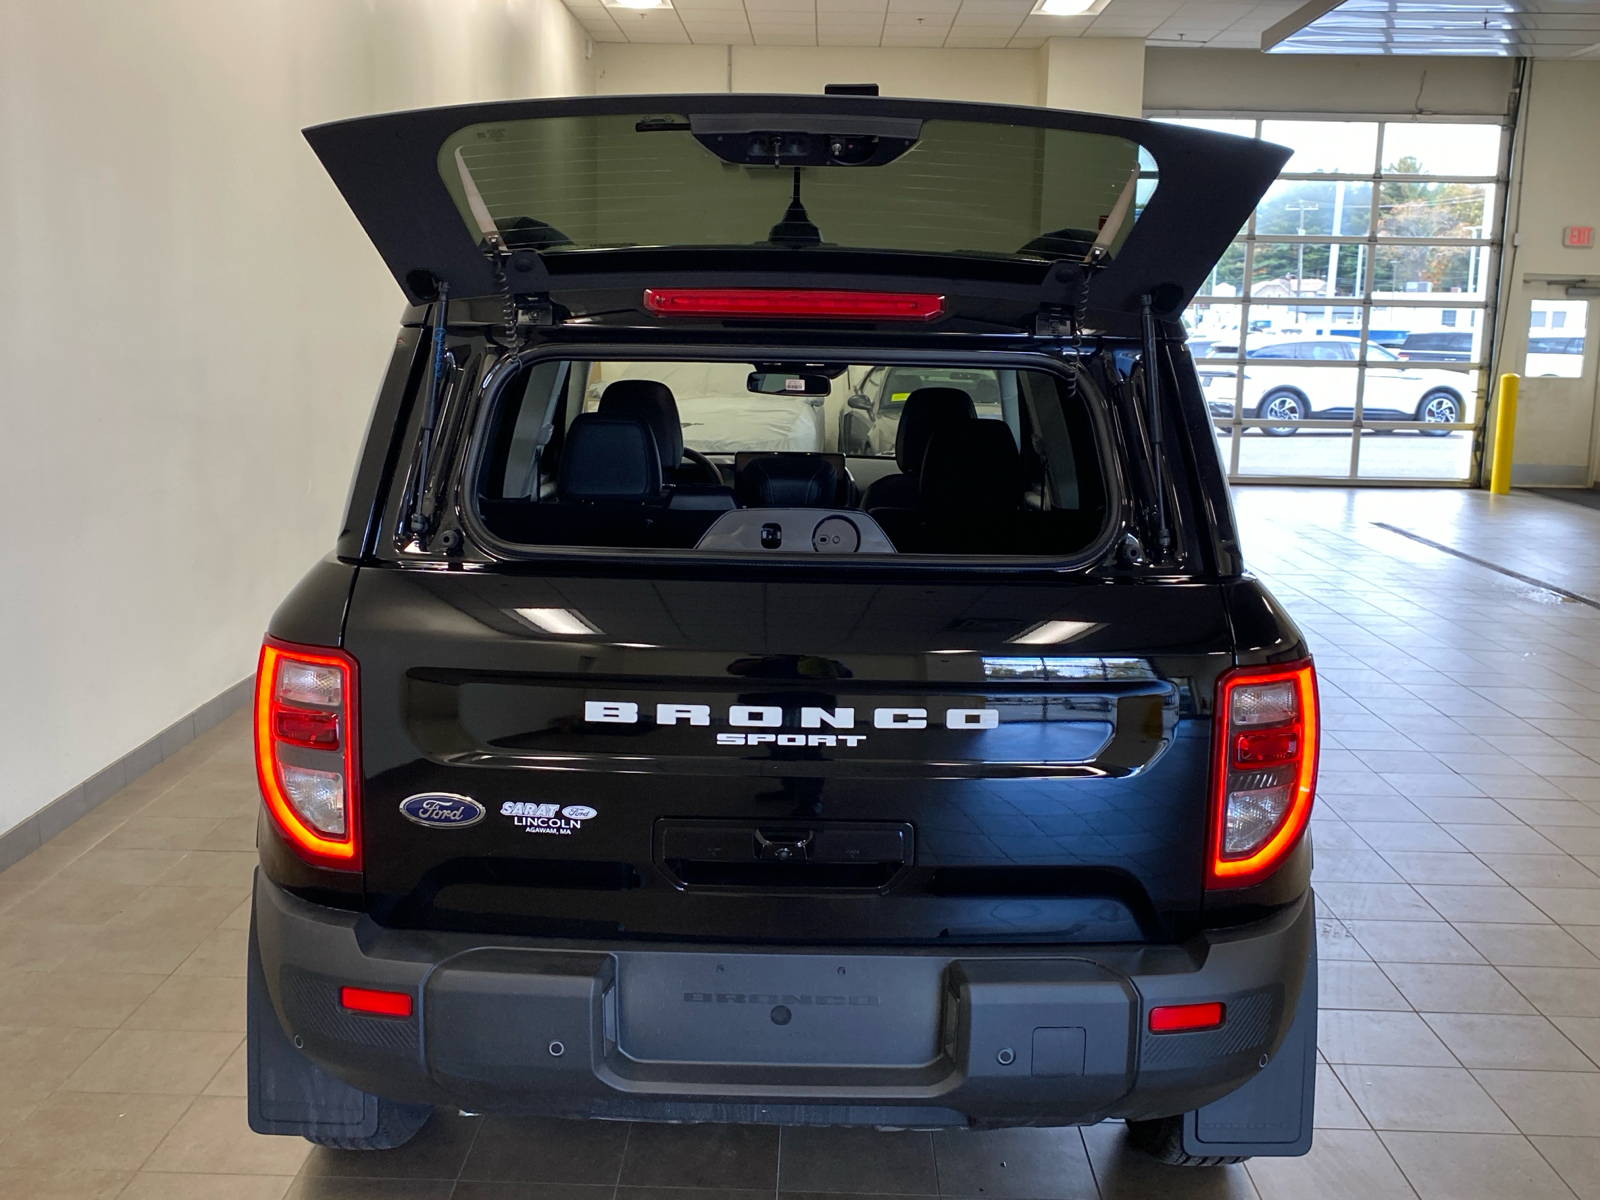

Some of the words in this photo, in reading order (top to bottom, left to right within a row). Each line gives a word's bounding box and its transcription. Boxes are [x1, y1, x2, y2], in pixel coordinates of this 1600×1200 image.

[1569, 226, 1592, 245] EXIT
[584, 701, 999, 729] BRONCO
[716, 732, 867, 747] SPORT
[418, 799, 464, 821] Ford
[500, 801, 560, 818] SARAT
[514, 816, 581, 829] LINCOLN
[525, 826, 559, 835] AGAWAM,
[683, 992, 881, 1006] BRONCO
